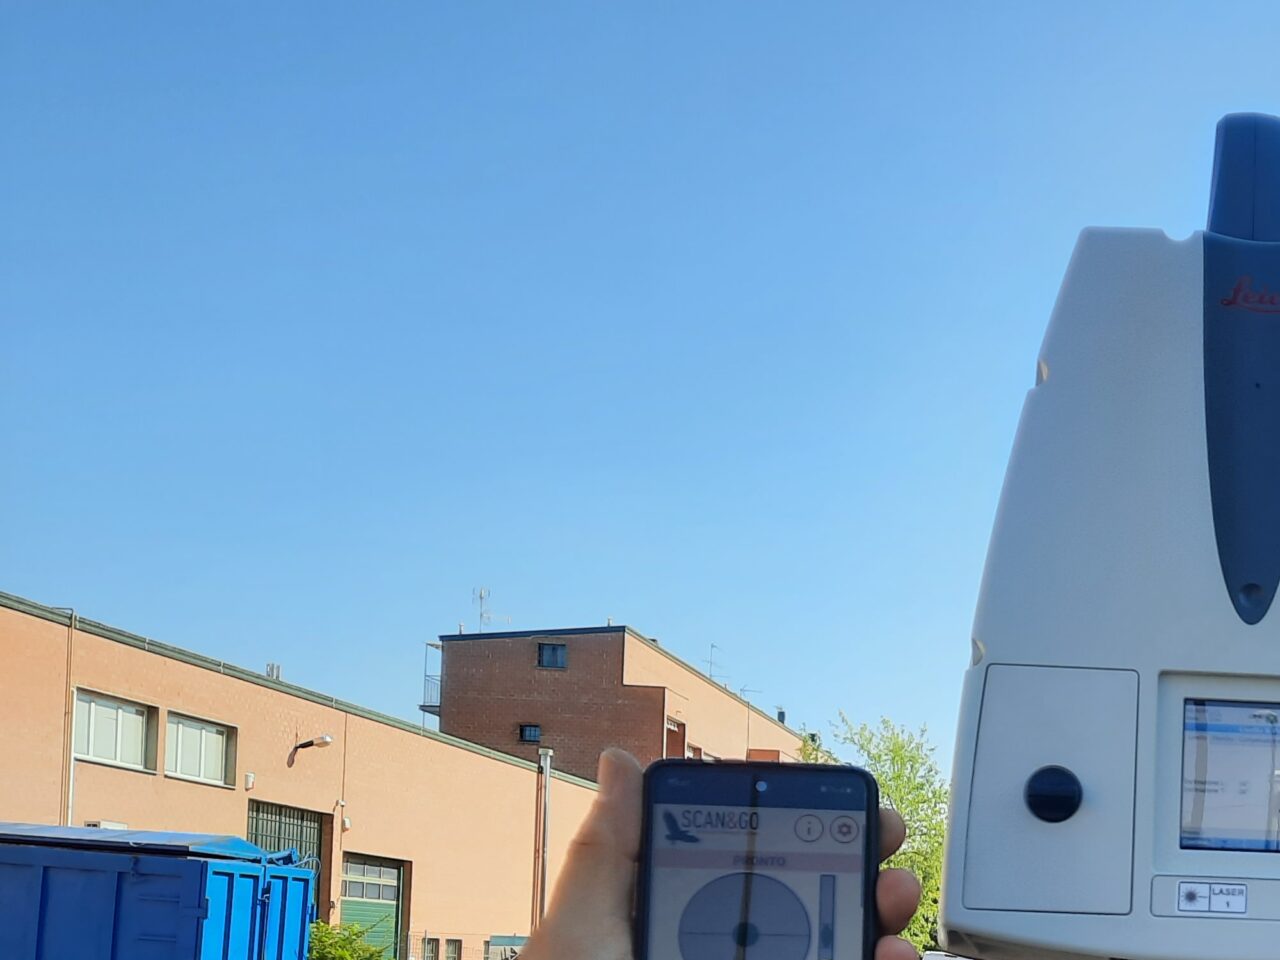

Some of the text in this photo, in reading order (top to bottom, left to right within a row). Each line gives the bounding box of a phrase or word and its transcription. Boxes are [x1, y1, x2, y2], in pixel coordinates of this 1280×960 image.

[681, 809, 759, 831] SCAN&GO
[733, 856, 786, 866] PRONTO
[1212, 888, 1244, 896] LASER
